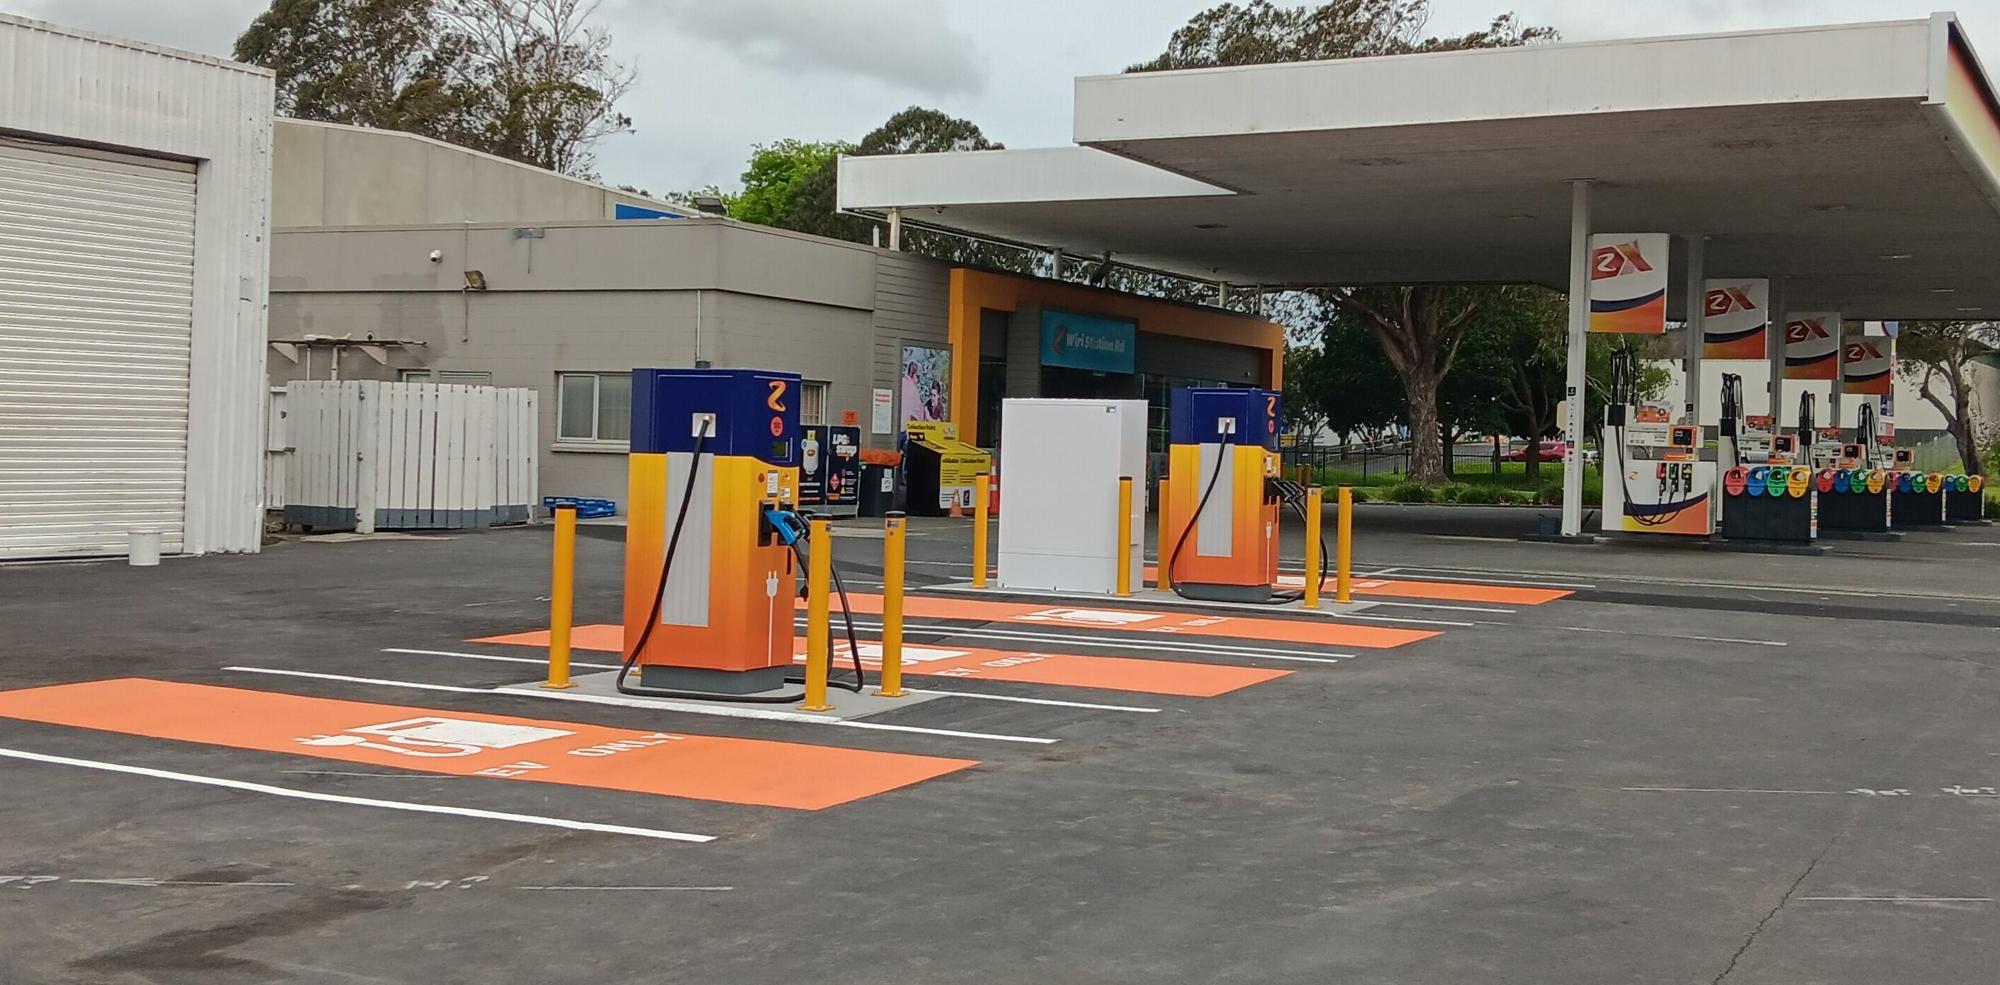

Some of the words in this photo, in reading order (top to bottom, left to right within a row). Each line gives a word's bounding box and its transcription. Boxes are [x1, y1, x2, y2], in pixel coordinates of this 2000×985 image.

[1066, 332, 1085, 348] Wiri
[1085, 336, 1115, 352] Station
[1115, 339, 1126, 353] Rd
[767, 380, 787, 413] Z
[473, 760, 550, 777] EV
[567, 732, 685, 757] ONLY
